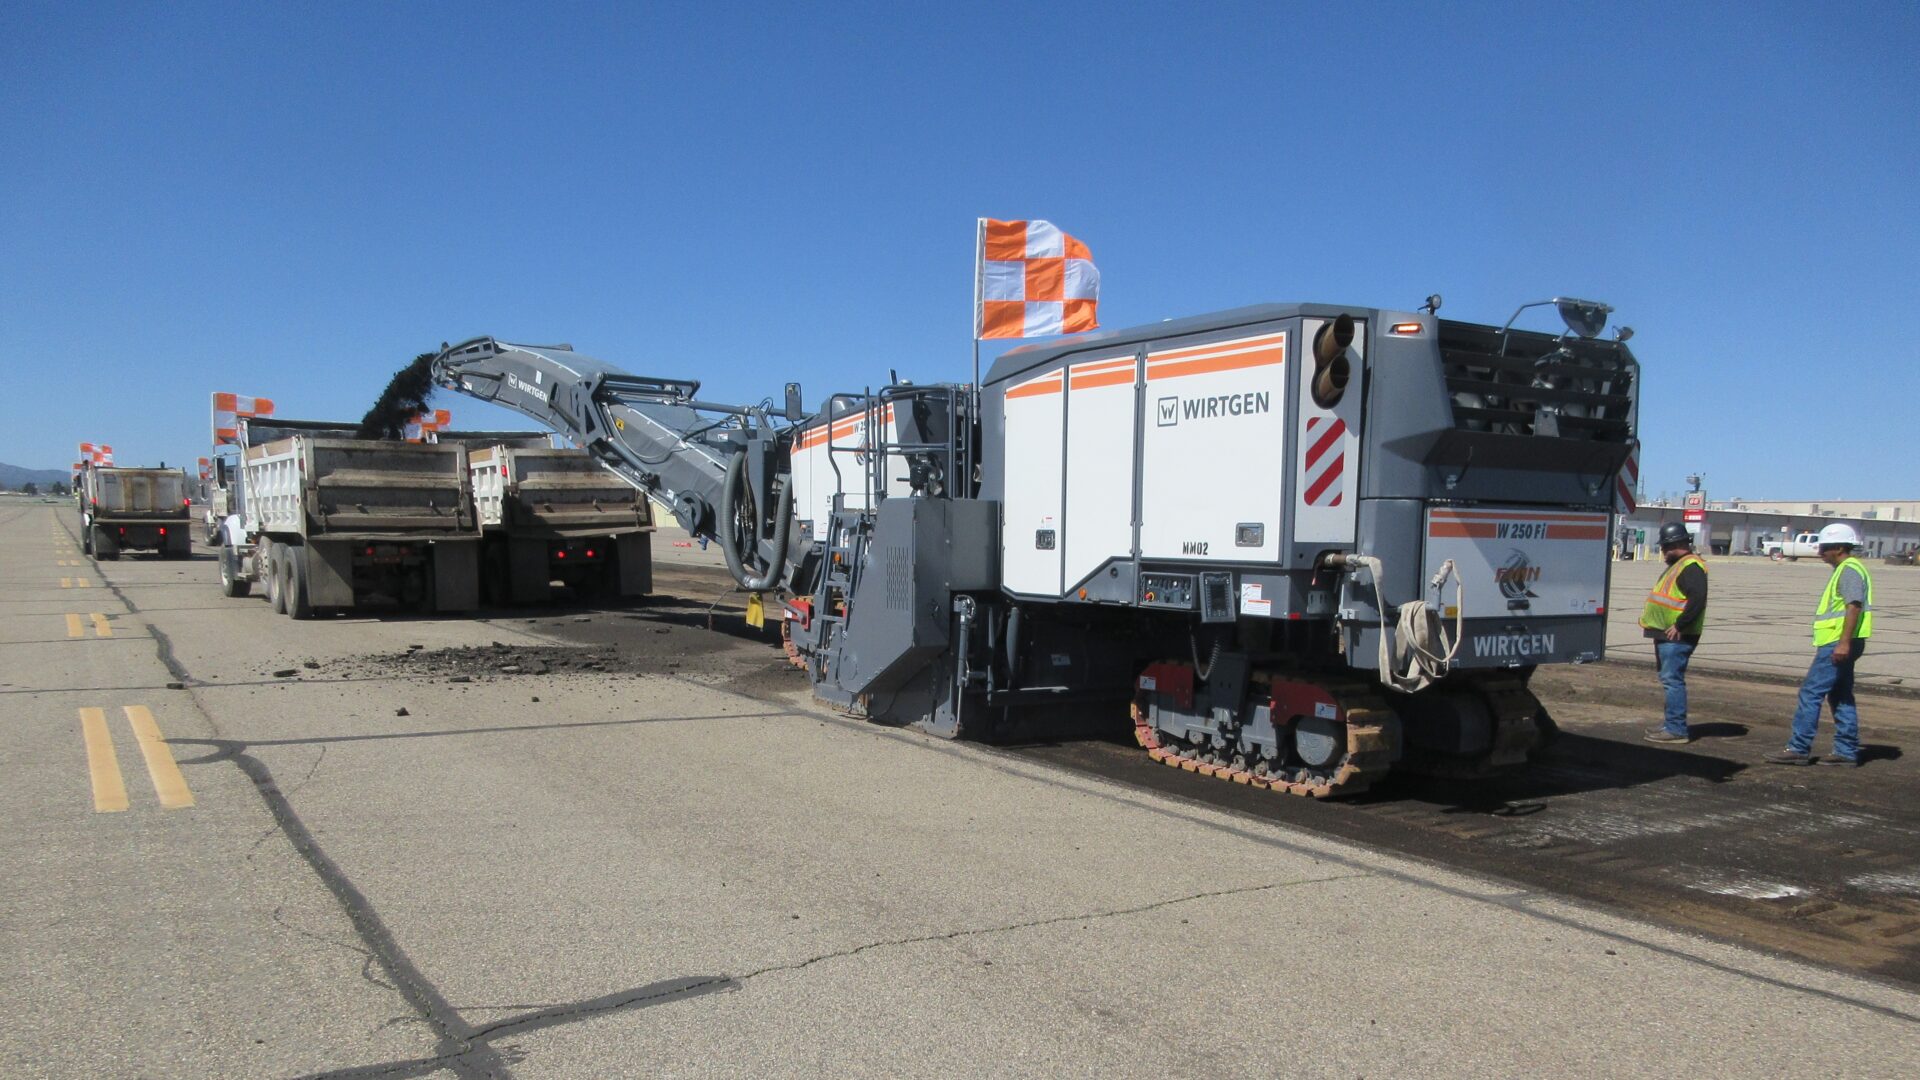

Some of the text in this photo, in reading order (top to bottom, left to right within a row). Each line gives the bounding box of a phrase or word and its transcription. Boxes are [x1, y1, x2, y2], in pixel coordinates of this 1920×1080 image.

[518, 380, 548, 403] WIRTGEN
[1183, 391, 1269, 420] WIRTGEN
[1498, 523, 1546, 539] W 250 Fi
[1473, 634, 1554, 657] WIRTGEN
